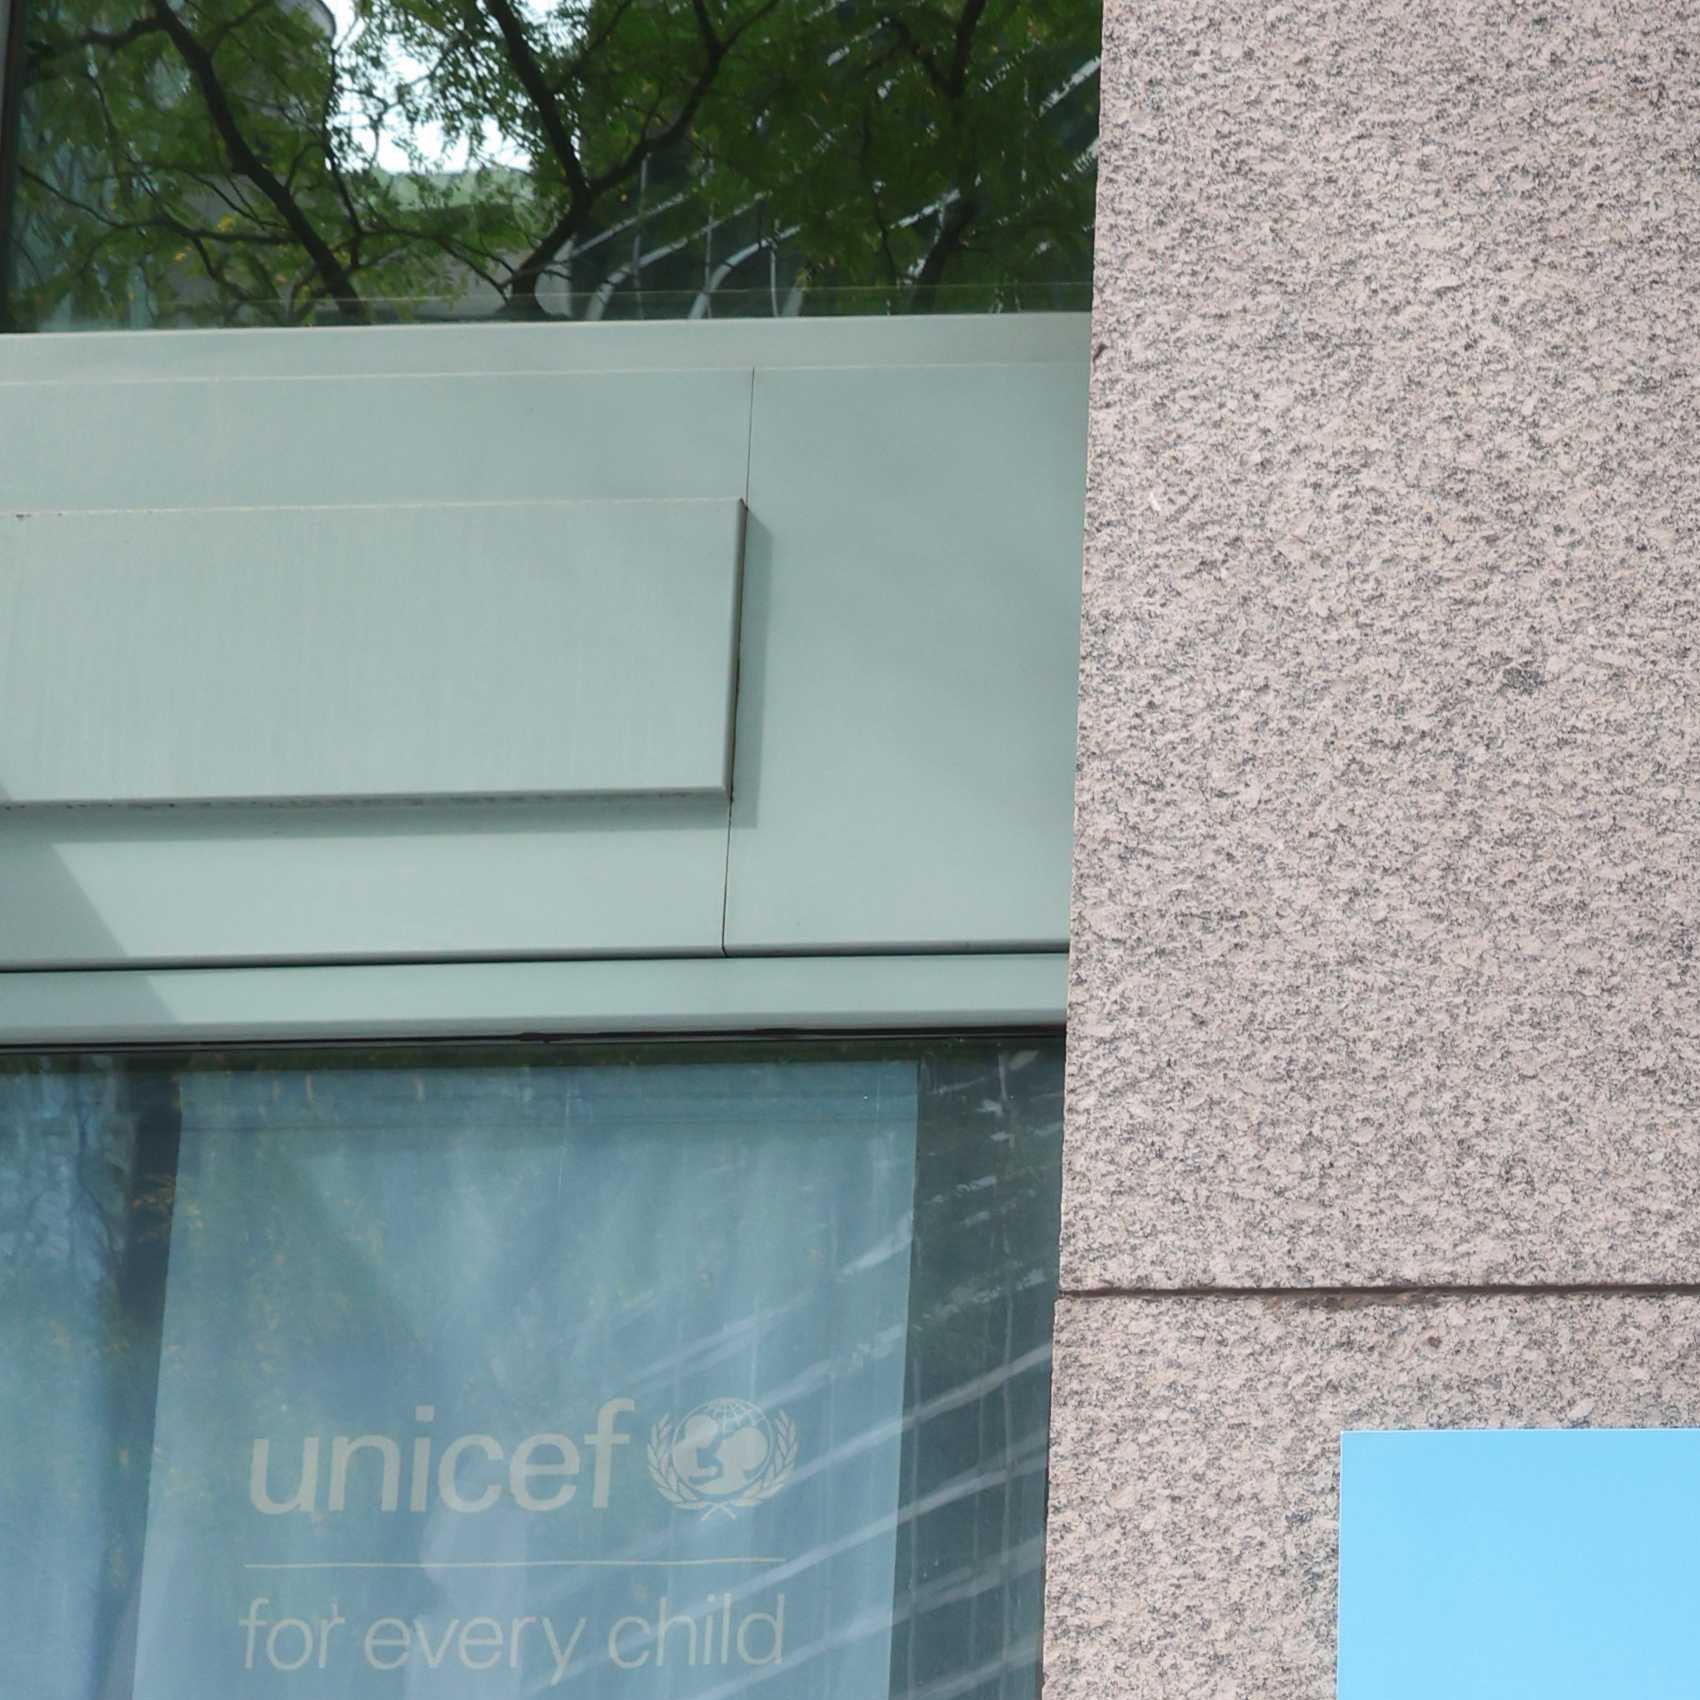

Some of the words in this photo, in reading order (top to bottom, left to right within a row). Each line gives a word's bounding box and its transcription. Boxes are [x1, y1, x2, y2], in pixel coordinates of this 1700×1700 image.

[251, 1397, 636, 1514] unicef
[241, 1597, 345, 1671] for
[365, 1614, 587, 1687] every
[608, 1594, 786, 1668] child
